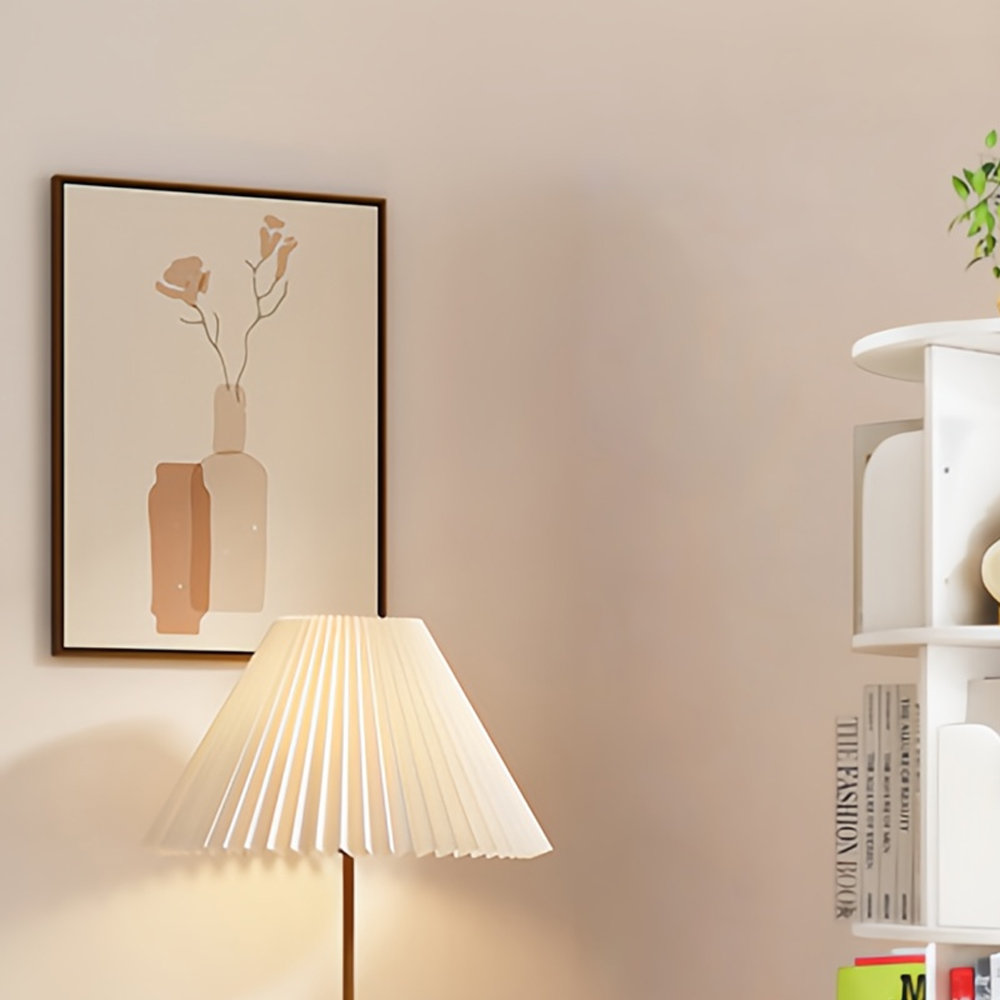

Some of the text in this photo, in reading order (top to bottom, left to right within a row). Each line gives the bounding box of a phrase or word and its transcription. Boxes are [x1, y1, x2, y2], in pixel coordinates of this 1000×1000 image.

[836, 716, 859, 919] THE FASHION BOOK
